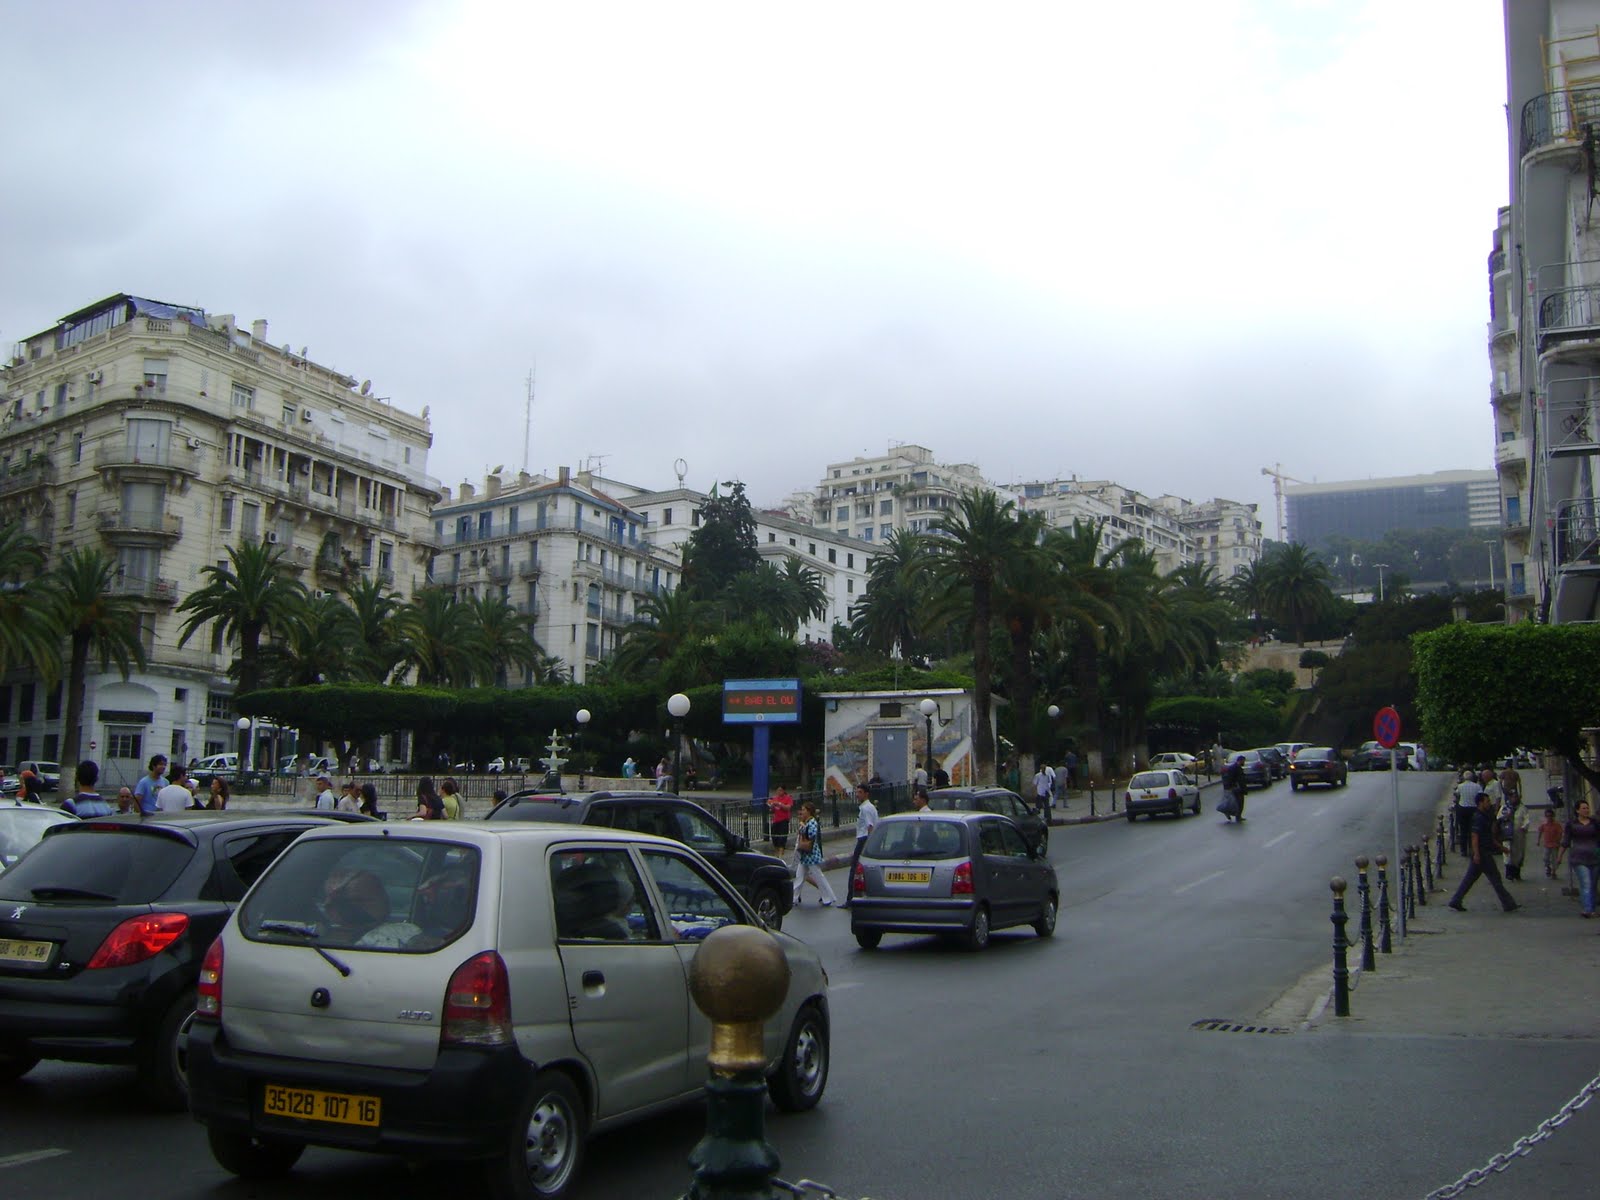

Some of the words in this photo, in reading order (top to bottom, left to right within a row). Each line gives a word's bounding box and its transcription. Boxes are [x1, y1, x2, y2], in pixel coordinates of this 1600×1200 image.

[745, 695, 763, 705] BAB
[767, 695, 777, 705] EL
[398, 1010, 432, 1021] ALTO
[268, 1089, 315, 1115] 35128
[324, 1096, 349, 1119] 107
[358, 1101, 376, 1122] 16
